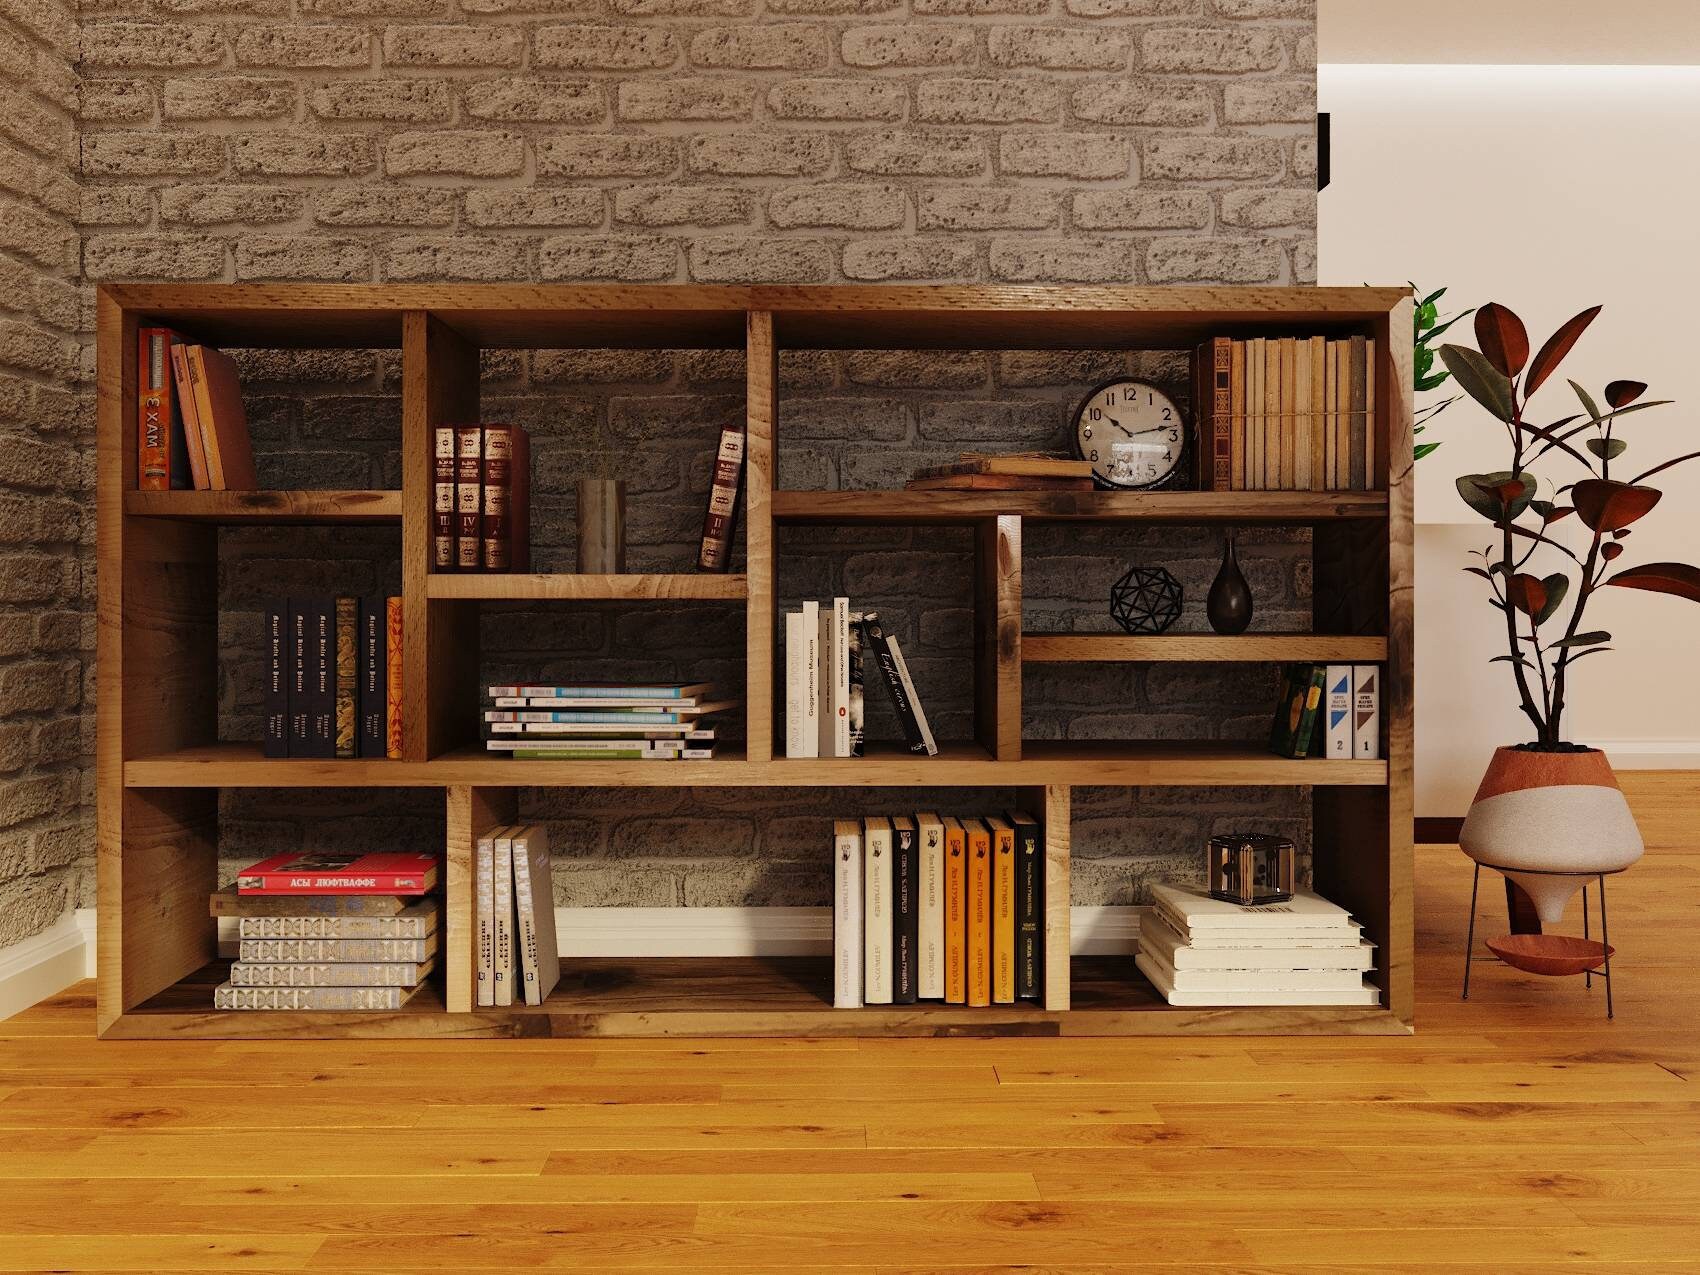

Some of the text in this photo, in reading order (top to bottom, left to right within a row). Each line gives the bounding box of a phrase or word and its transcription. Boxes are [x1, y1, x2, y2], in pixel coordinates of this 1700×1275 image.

[1106, 393, 1115, 405] 11
[1124, 388, 1136, 401] 12
[1149, 393, 1153, 405] 1
[1089, 408, 1102, 421] 10
[1162, 408, 1171, 421] 2
[1083, 430, 1092, 441] 9
[1169, 430, 1178, 442] 3
[1090, 450, 1099, 462] 8
[1162, 450, 1173, 462] 4
[1106, 465, 1115, 474] 7
[1148, 464, 1157, 477] 5
[463, 516, 475, 527] IV
[894, 687, 907, 712] circus
[1337, 740, 1343, 750] 2
[1364, 741, 1369, 750] 1
[290, 877, 376, 887] АСЫ ЛЮФТВАФФЕ
